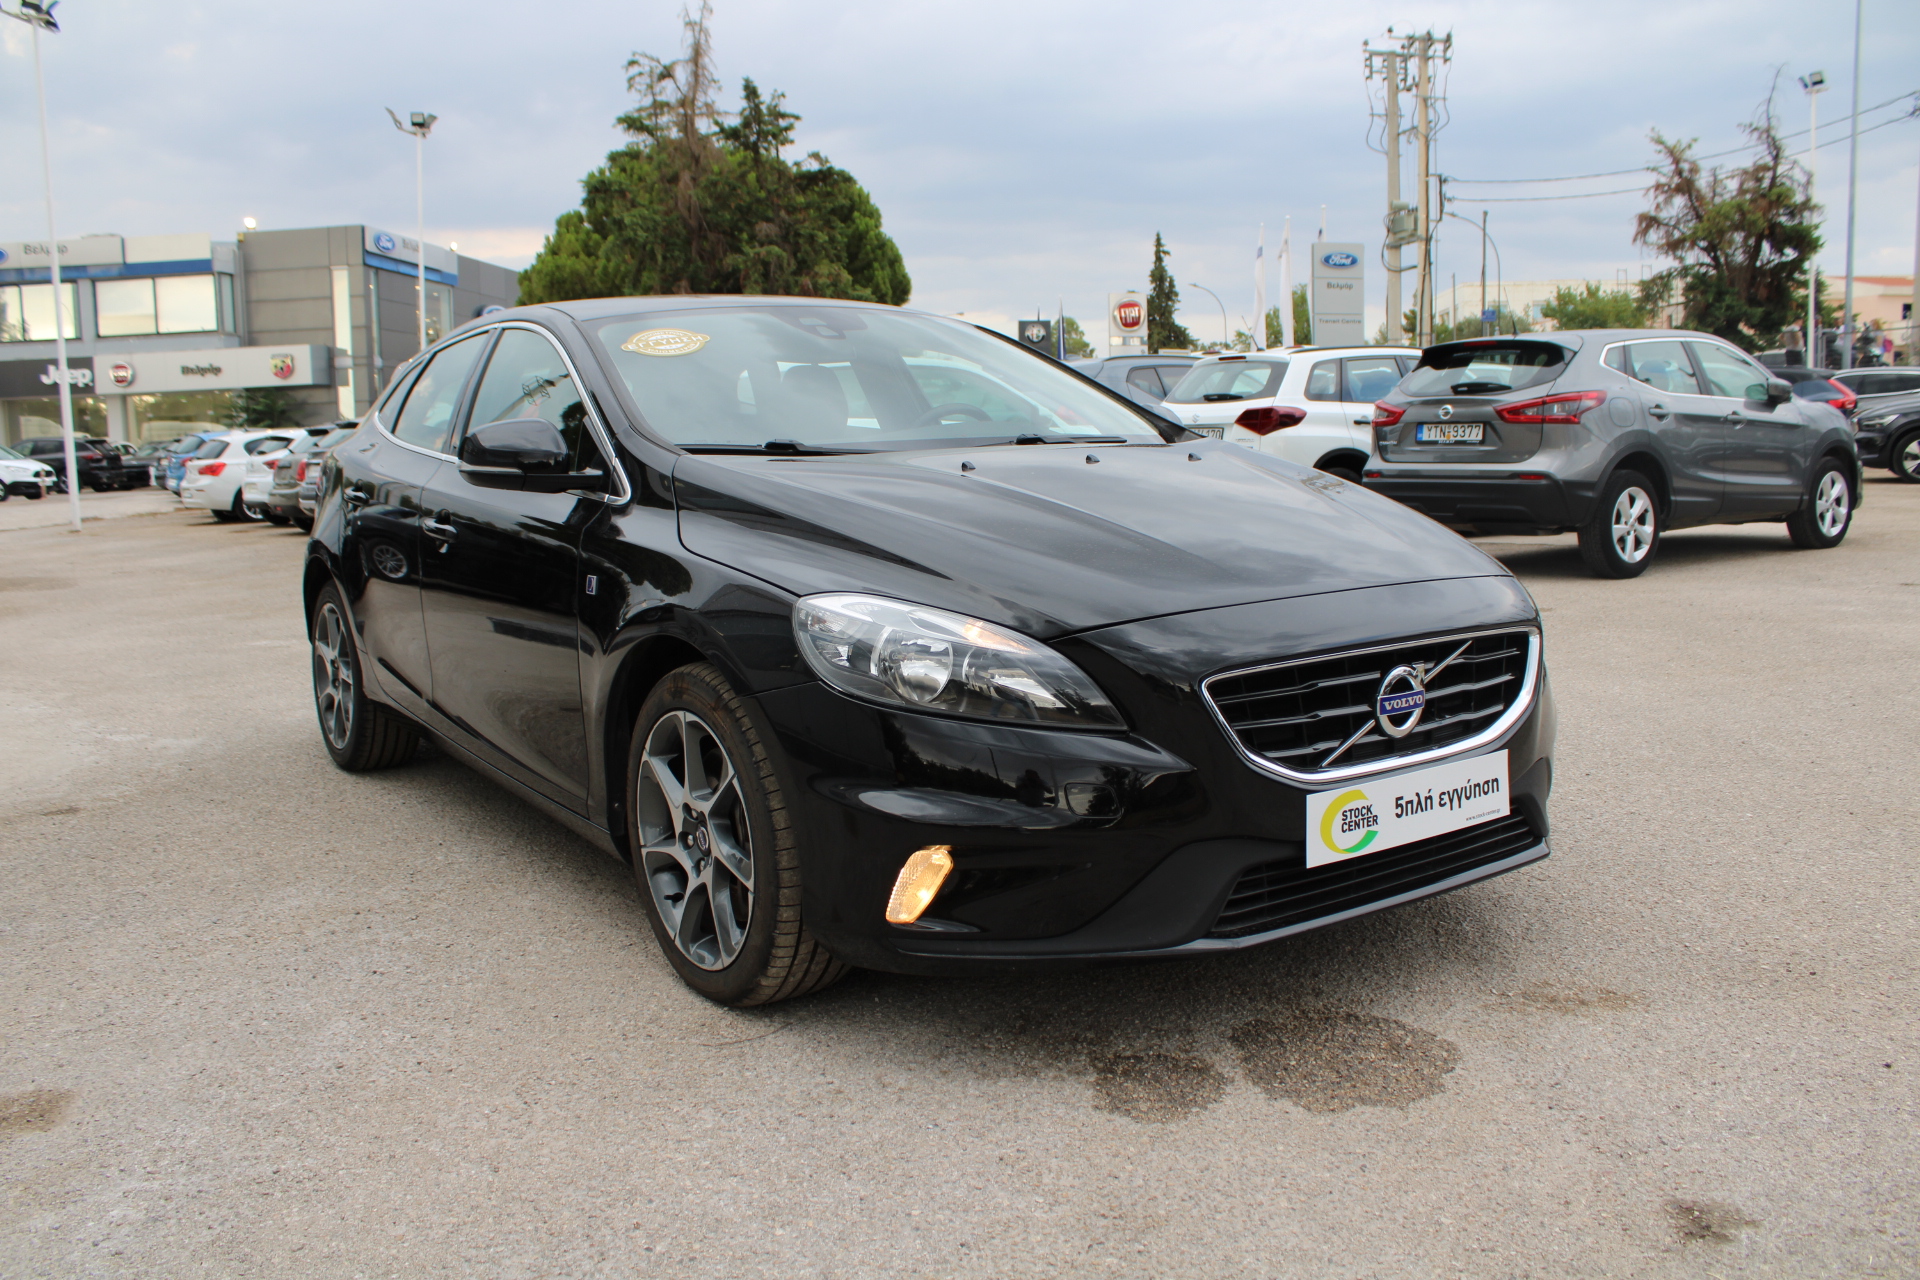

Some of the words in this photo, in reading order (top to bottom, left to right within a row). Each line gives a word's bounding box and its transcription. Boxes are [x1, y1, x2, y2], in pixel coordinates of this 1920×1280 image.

[23, 243, 68, 257] Βελμρ
[1329, 253, 1353, 265] Ford
[1120, 306, 1140, 323] FIAT
[627, 335, 704, 350] ΕΓΓΥΗΣΗ
[1383, 694, 1423, 710] VOLVO
[1394, 789, 1434, 818] 5πλή
[1438, 778, 1500, 811] εγγύηση
[1341, 803, 1373, 821] STOCK
[1341, 814, 1379, 833] CENTER
